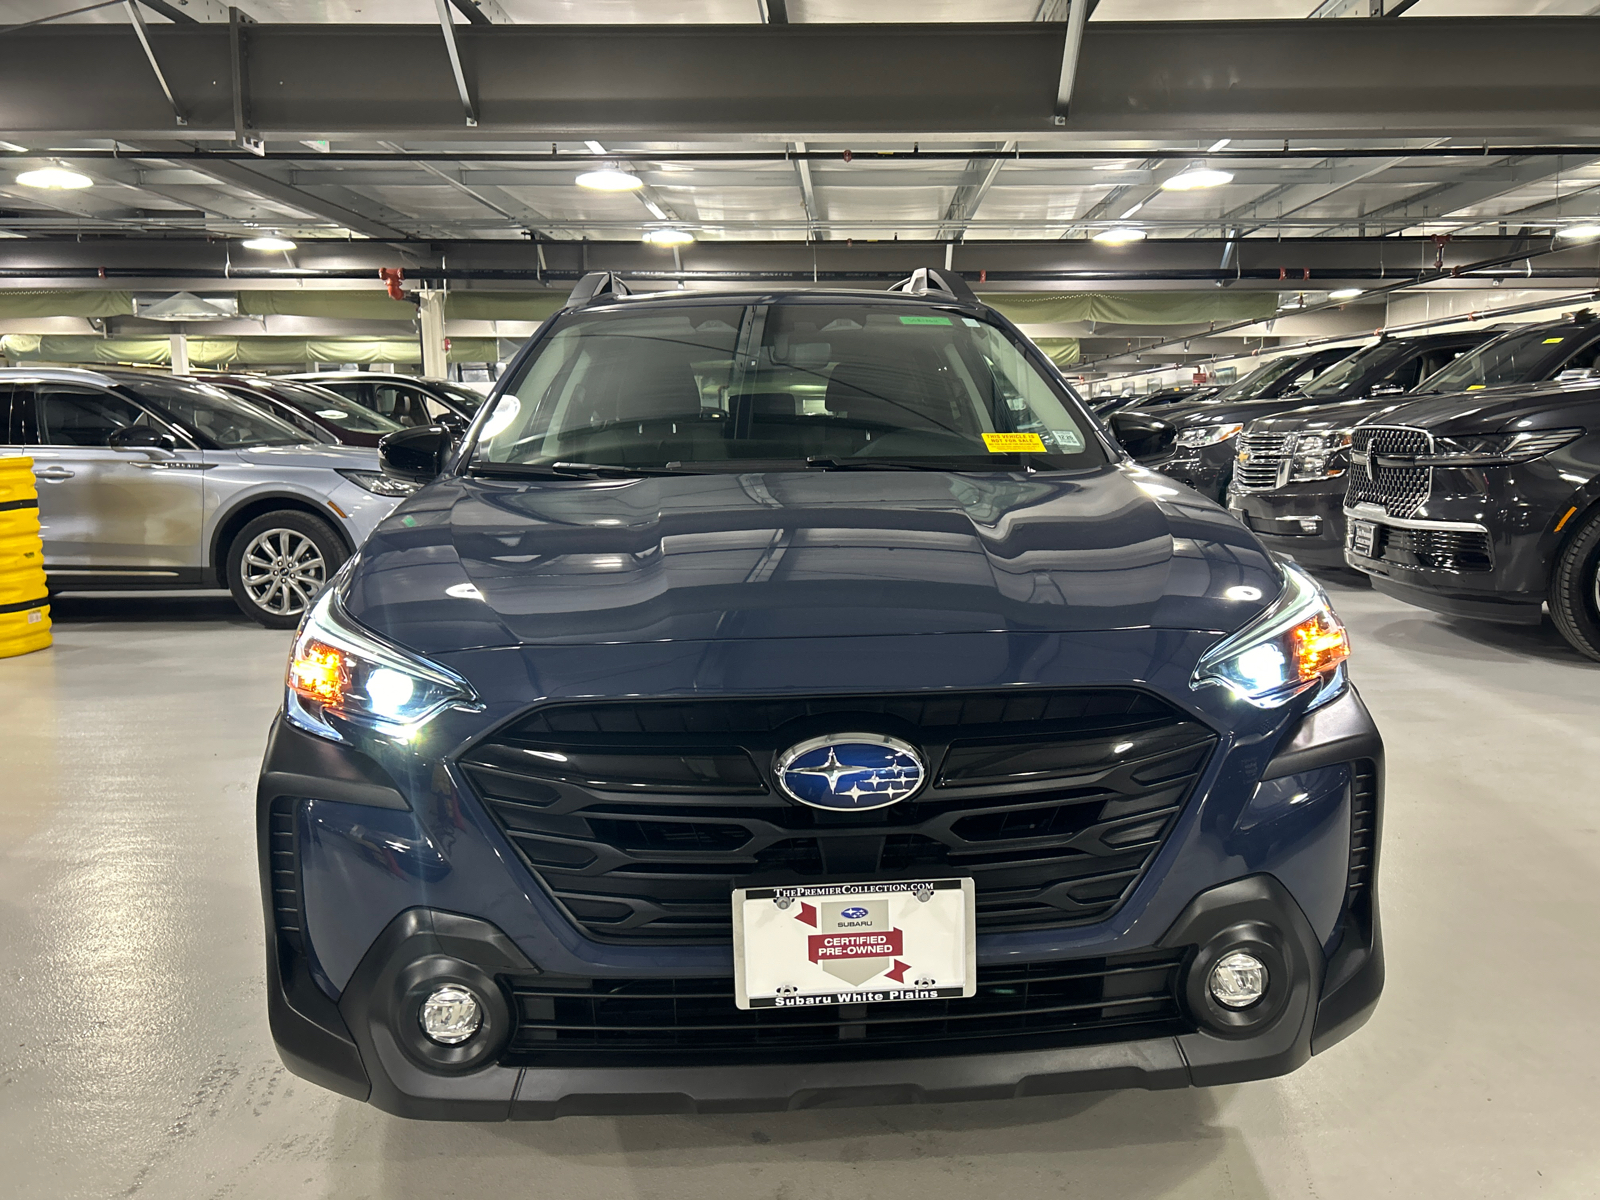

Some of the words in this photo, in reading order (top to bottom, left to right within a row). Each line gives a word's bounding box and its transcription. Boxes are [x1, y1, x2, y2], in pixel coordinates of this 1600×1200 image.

[837, 920, 873, 928] SUBARU
[824, 935, 887, 946] CERTIFIED
[818, 944, 893, 956] PRE-OWNED
[775, 995, 832, 1007] Subaru
[837, 992, 884, 1003] White
[889, 989, 938, 999] Plains
